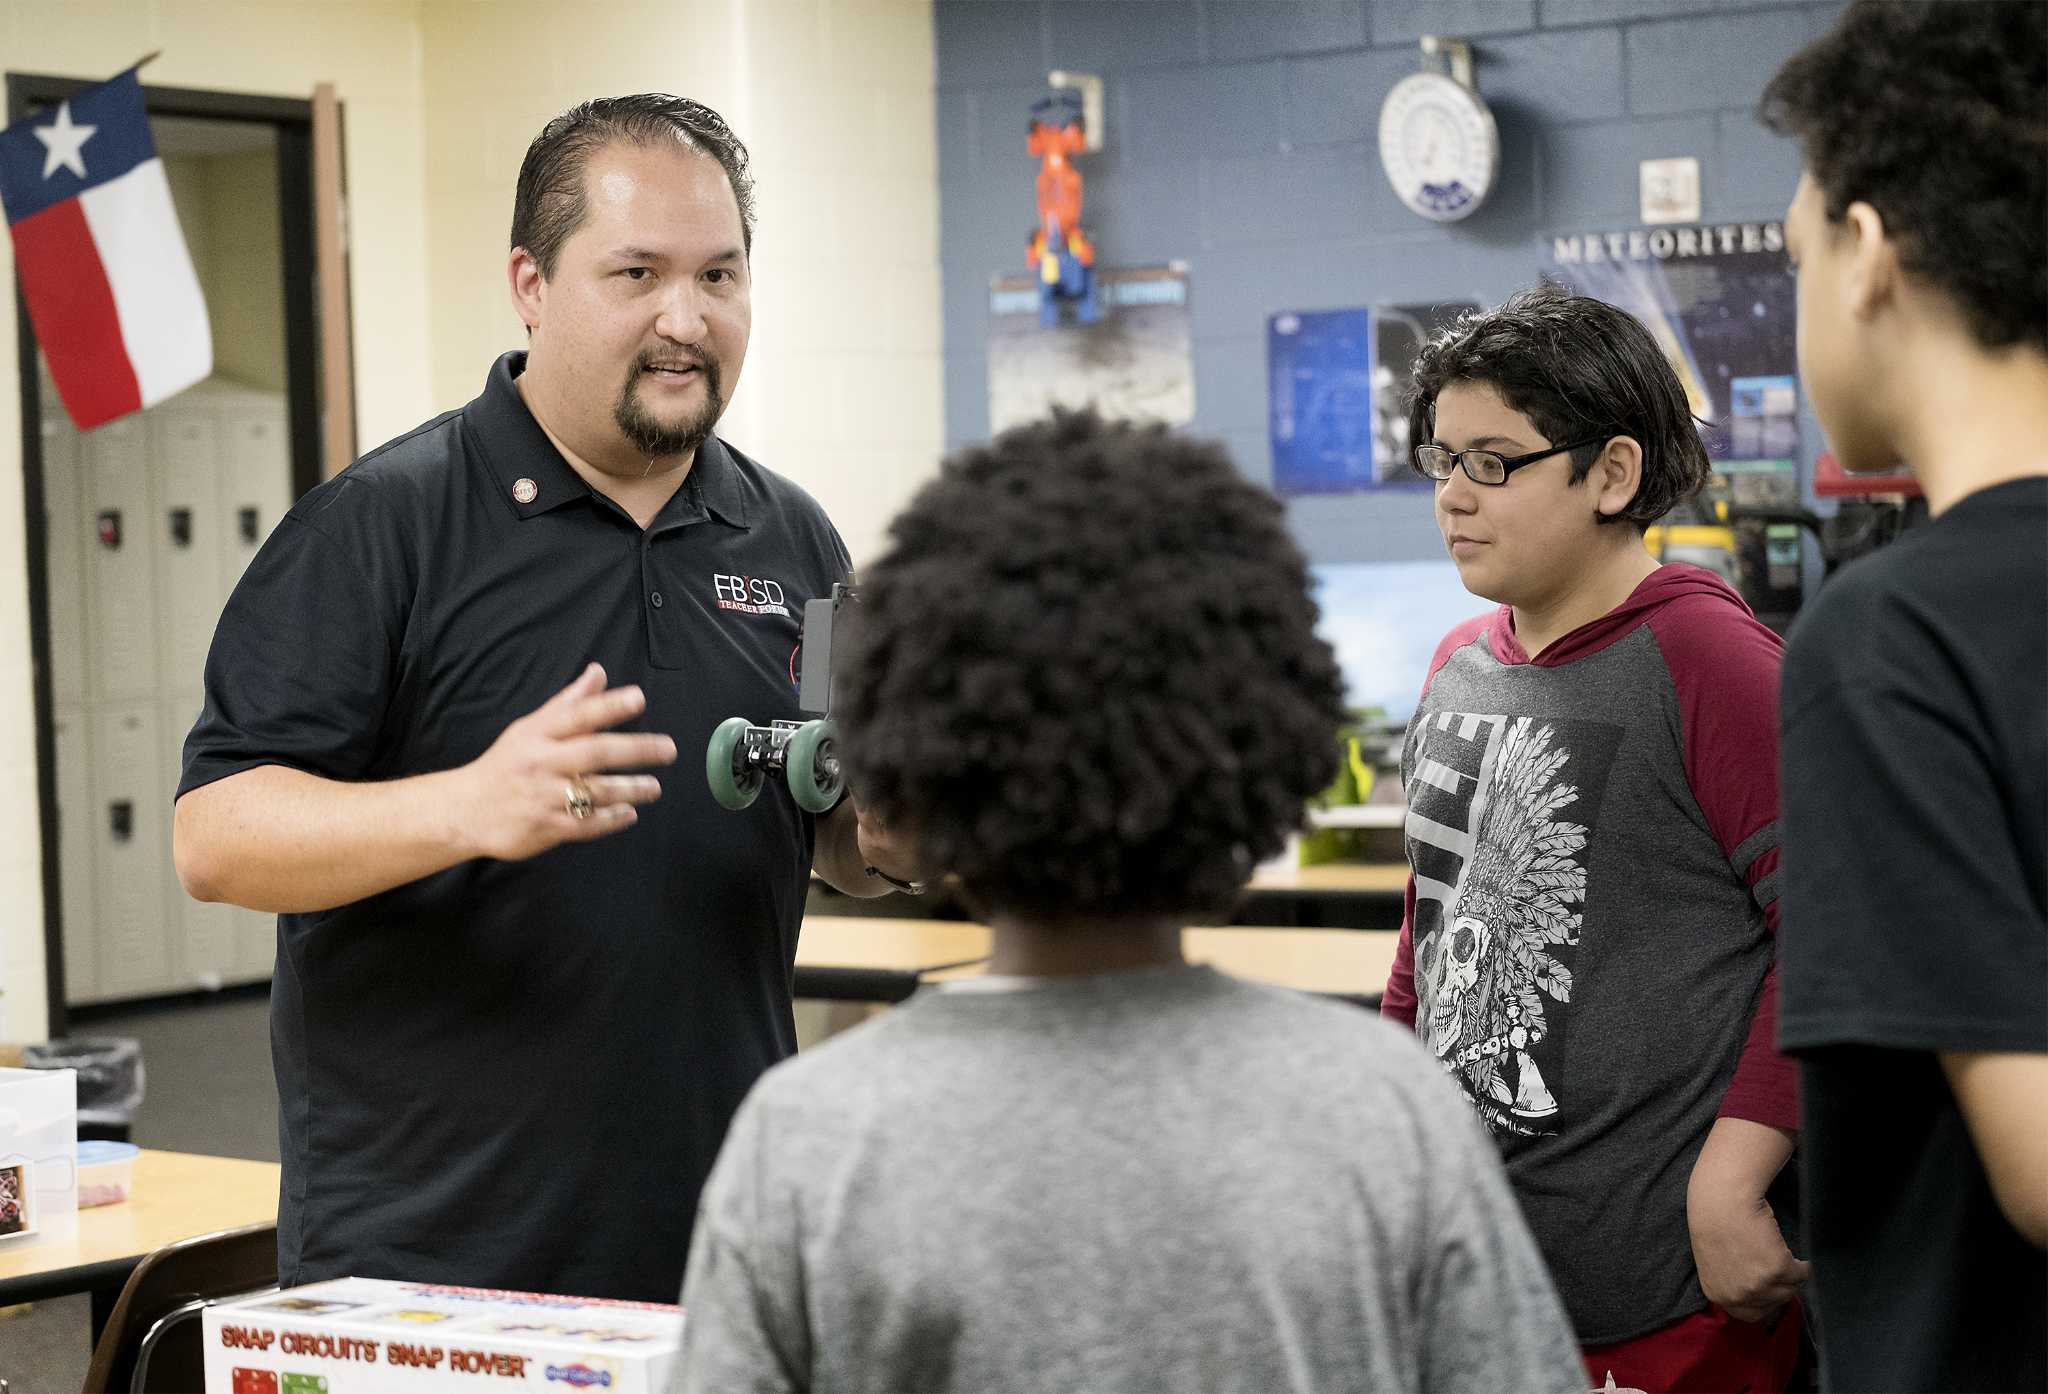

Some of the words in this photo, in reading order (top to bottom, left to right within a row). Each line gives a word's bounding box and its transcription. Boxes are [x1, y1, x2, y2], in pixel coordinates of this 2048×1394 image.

[1553, 222, 1784, 264] METEORITES
[718, 599, 759, 614] TEACHER
[221, 1324, 275, 1352] SNAP
[280, 1331, 377, 1363] CIRCUITS
[387, 1342, 444, 1370] SNAP
[449, 1348, 526, 1379] ROVER
